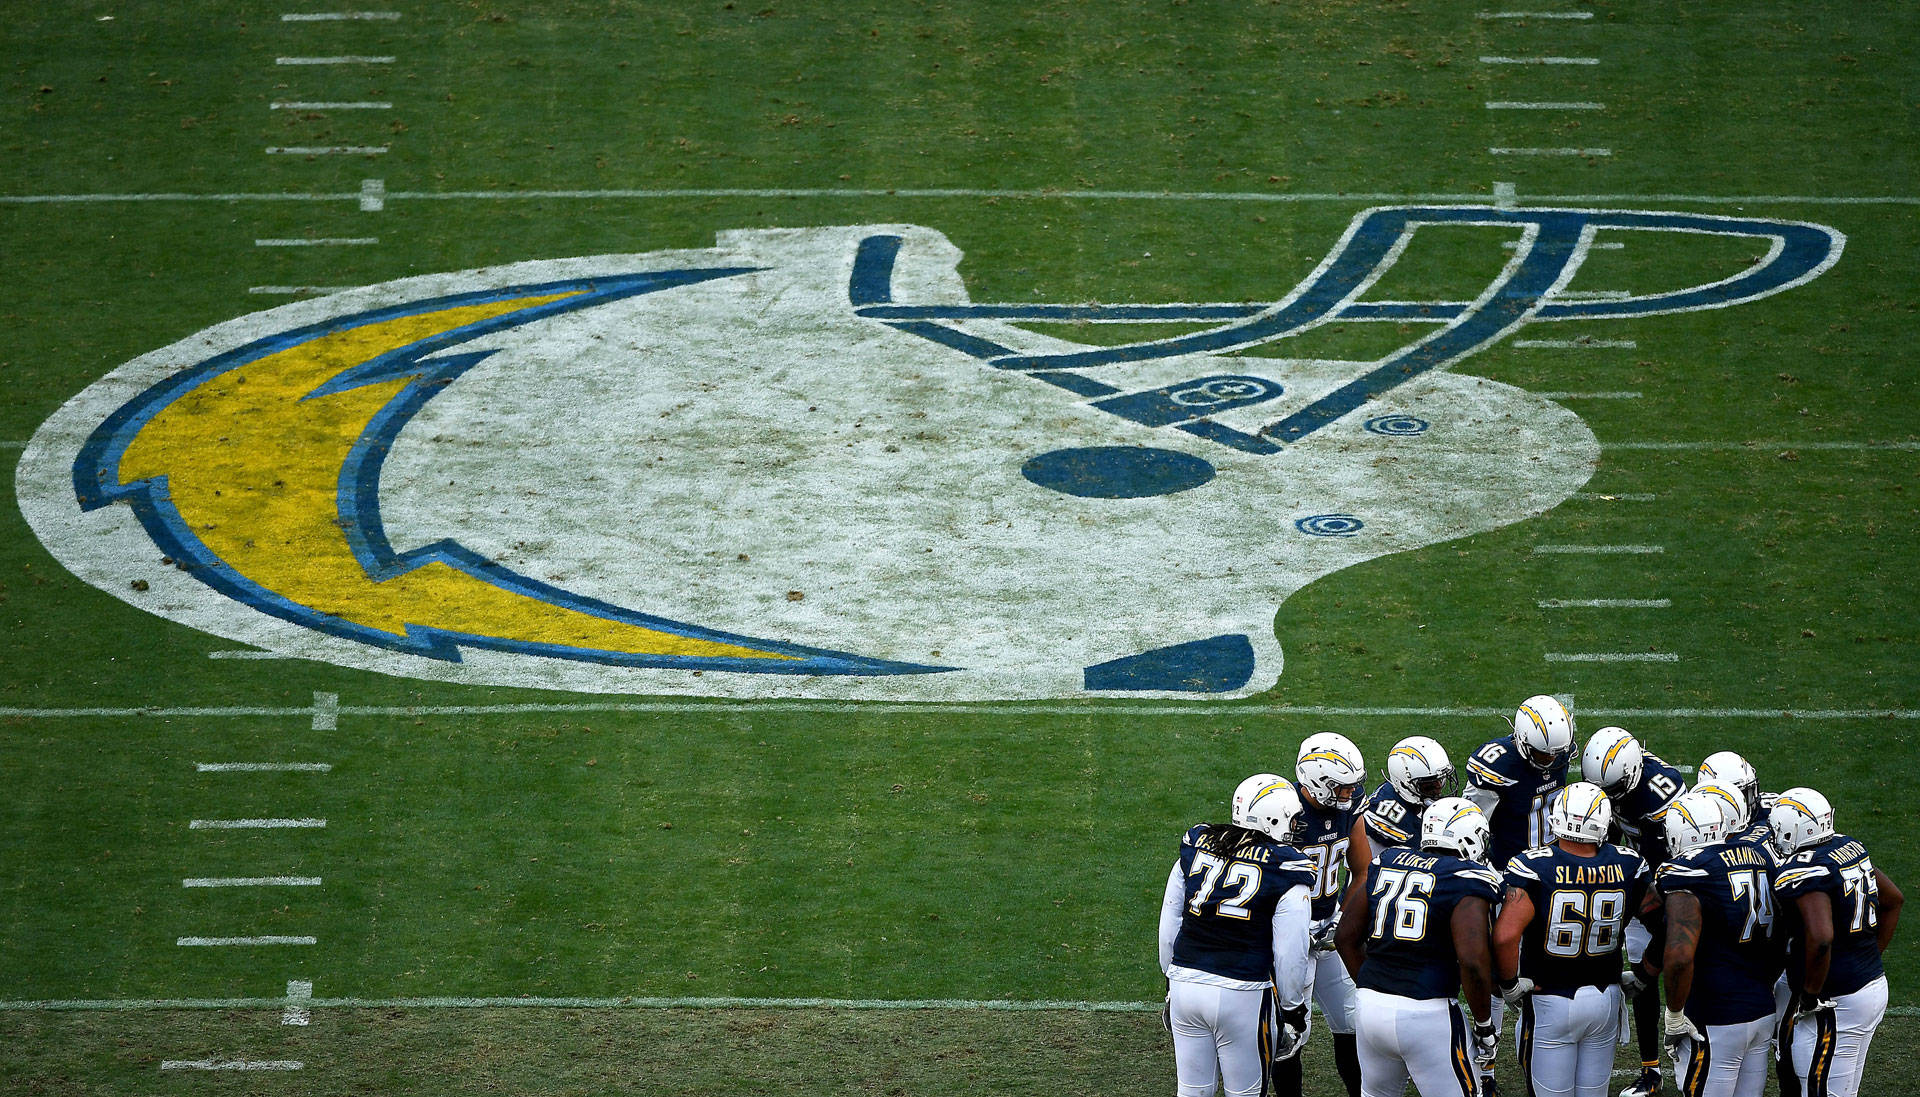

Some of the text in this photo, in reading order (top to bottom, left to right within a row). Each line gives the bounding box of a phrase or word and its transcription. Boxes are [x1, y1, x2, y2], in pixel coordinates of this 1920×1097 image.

[1477, 742, 1507, 764] 16
[1647, 773, 1678, 800] 15
[1567, 823, 1581, 833] 68
[1703, 832, 1716, 843] 74
[1828, 840, 1867, 866] HAIRSTO
[1189, 849, 1262, 921] 72
[1555, 864, 1625, 885] SLAUSON
[1371, 867, 1436, 941] 76
[1727, 869, 1774, 943] 74
[1544, 889, 1626, 958] 68
